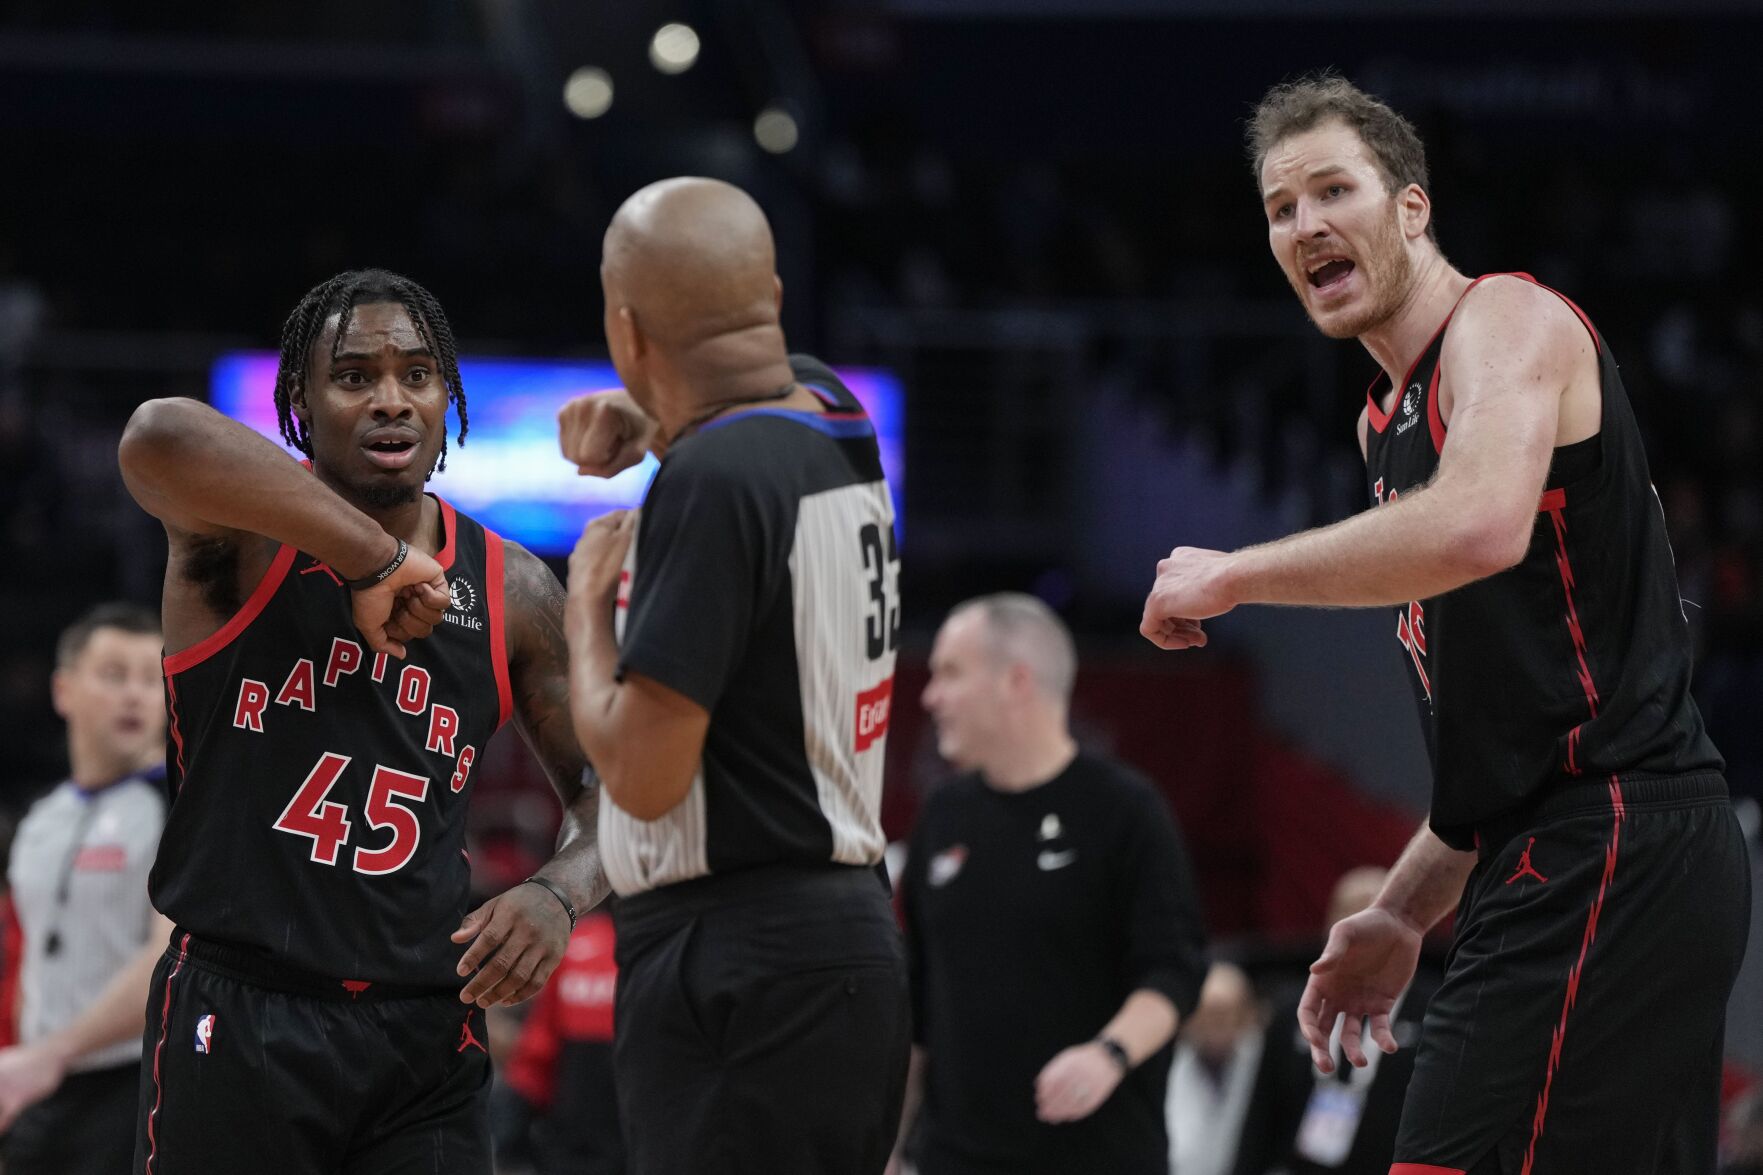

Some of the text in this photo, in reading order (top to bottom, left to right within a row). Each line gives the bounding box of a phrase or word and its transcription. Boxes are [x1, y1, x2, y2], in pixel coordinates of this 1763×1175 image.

[377, 561, 400, 581] WORK
[442, 608, 483, 631] un Life
[271, 751, 431, 876] 45
